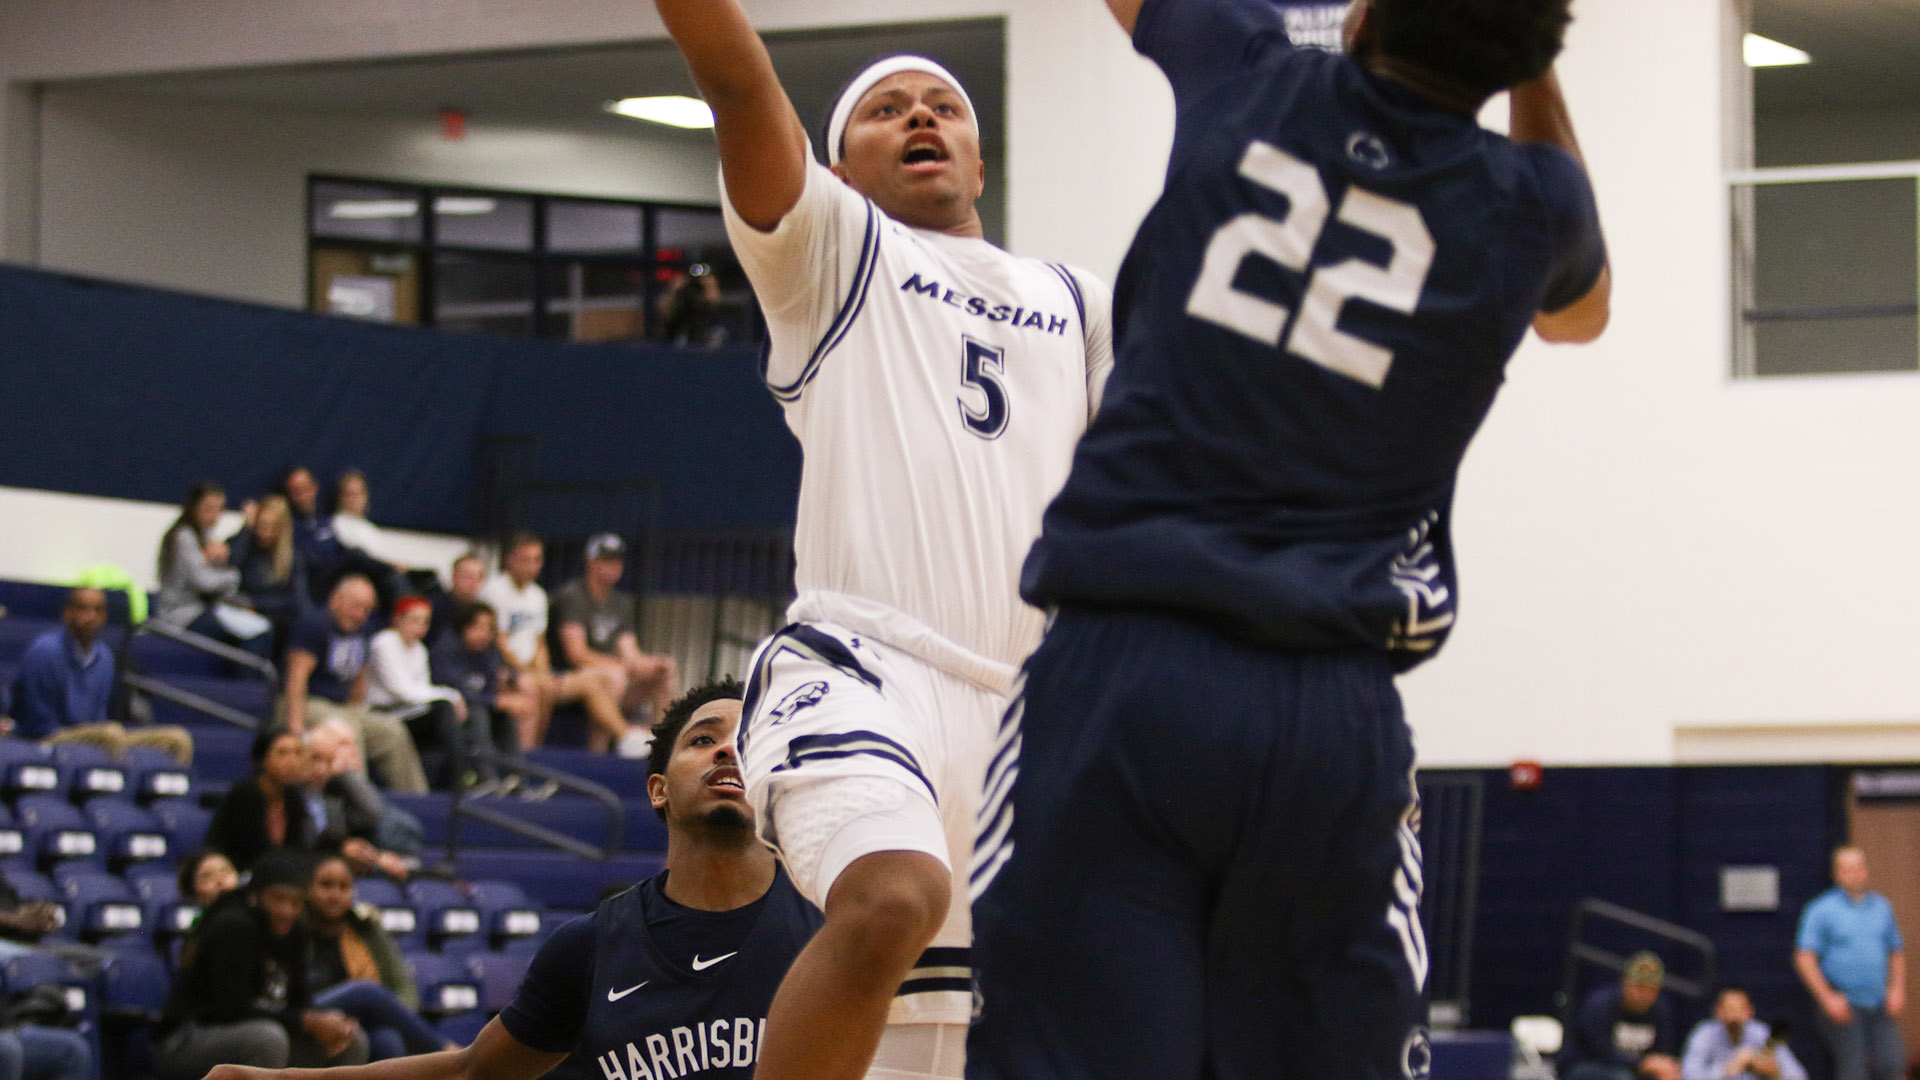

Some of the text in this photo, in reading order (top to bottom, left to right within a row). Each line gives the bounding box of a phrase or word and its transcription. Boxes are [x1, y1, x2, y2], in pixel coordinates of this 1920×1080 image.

[900, 273, 1068, 336] MESSIAH
[1185, 140, 1437, 390] 22
[957, 334, 1010, 441] 5
